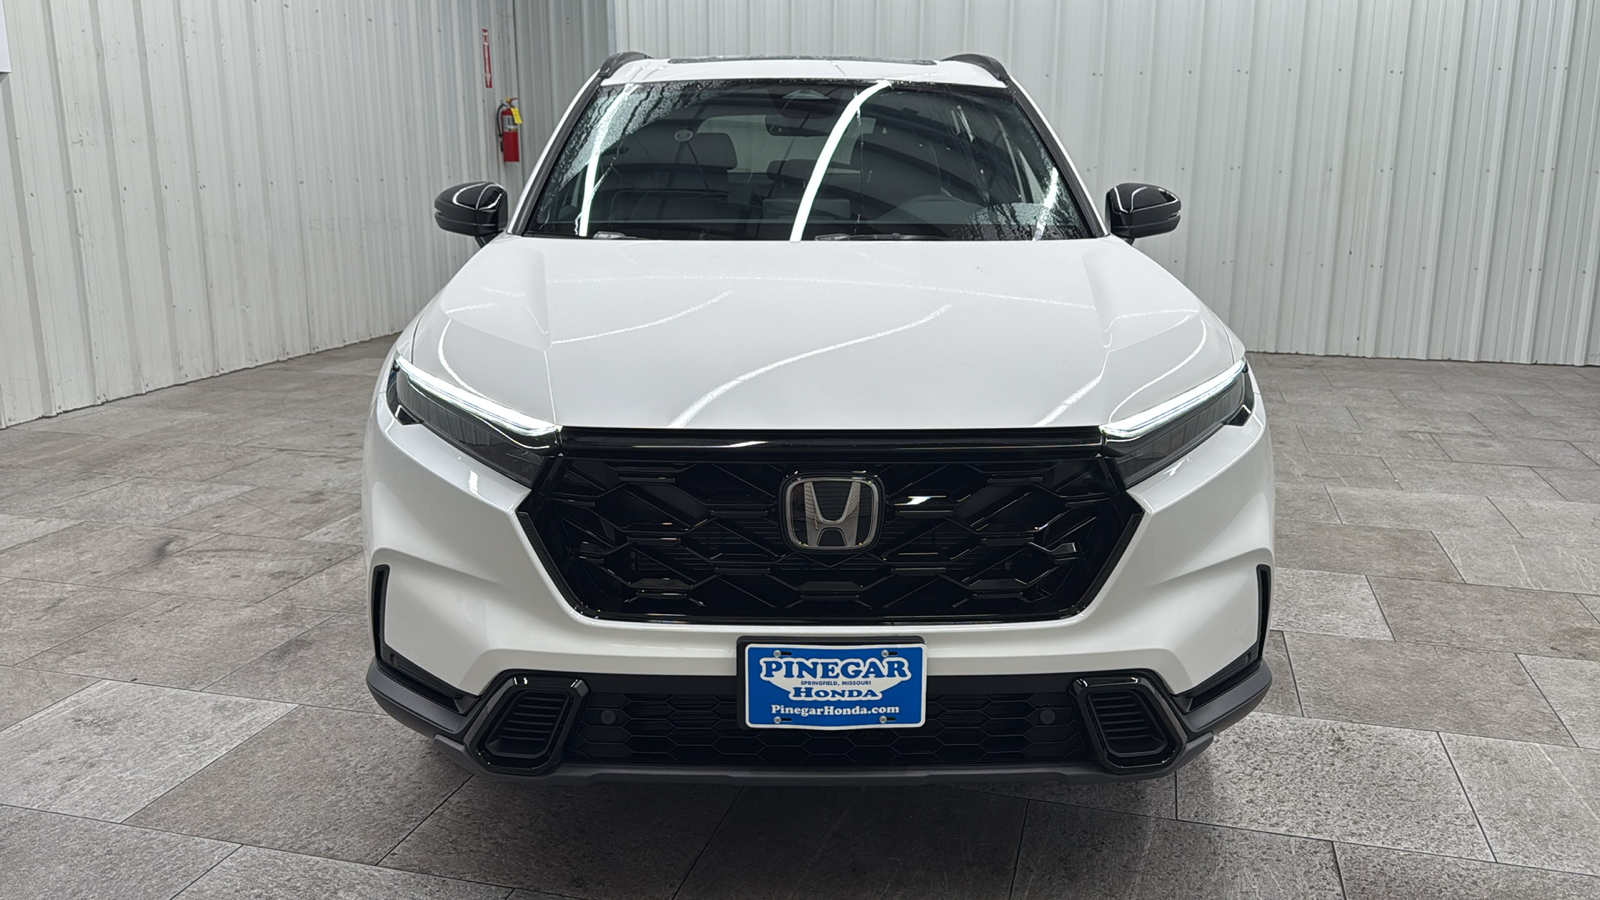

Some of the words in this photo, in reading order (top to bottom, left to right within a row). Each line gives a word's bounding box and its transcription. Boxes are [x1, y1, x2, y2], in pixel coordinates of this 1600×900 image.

[763, 661, 908, 679] PINEGAR
[792, 687, 879, 698] HONDA
[771, 705, 900, 717] PinegarHonda.com
